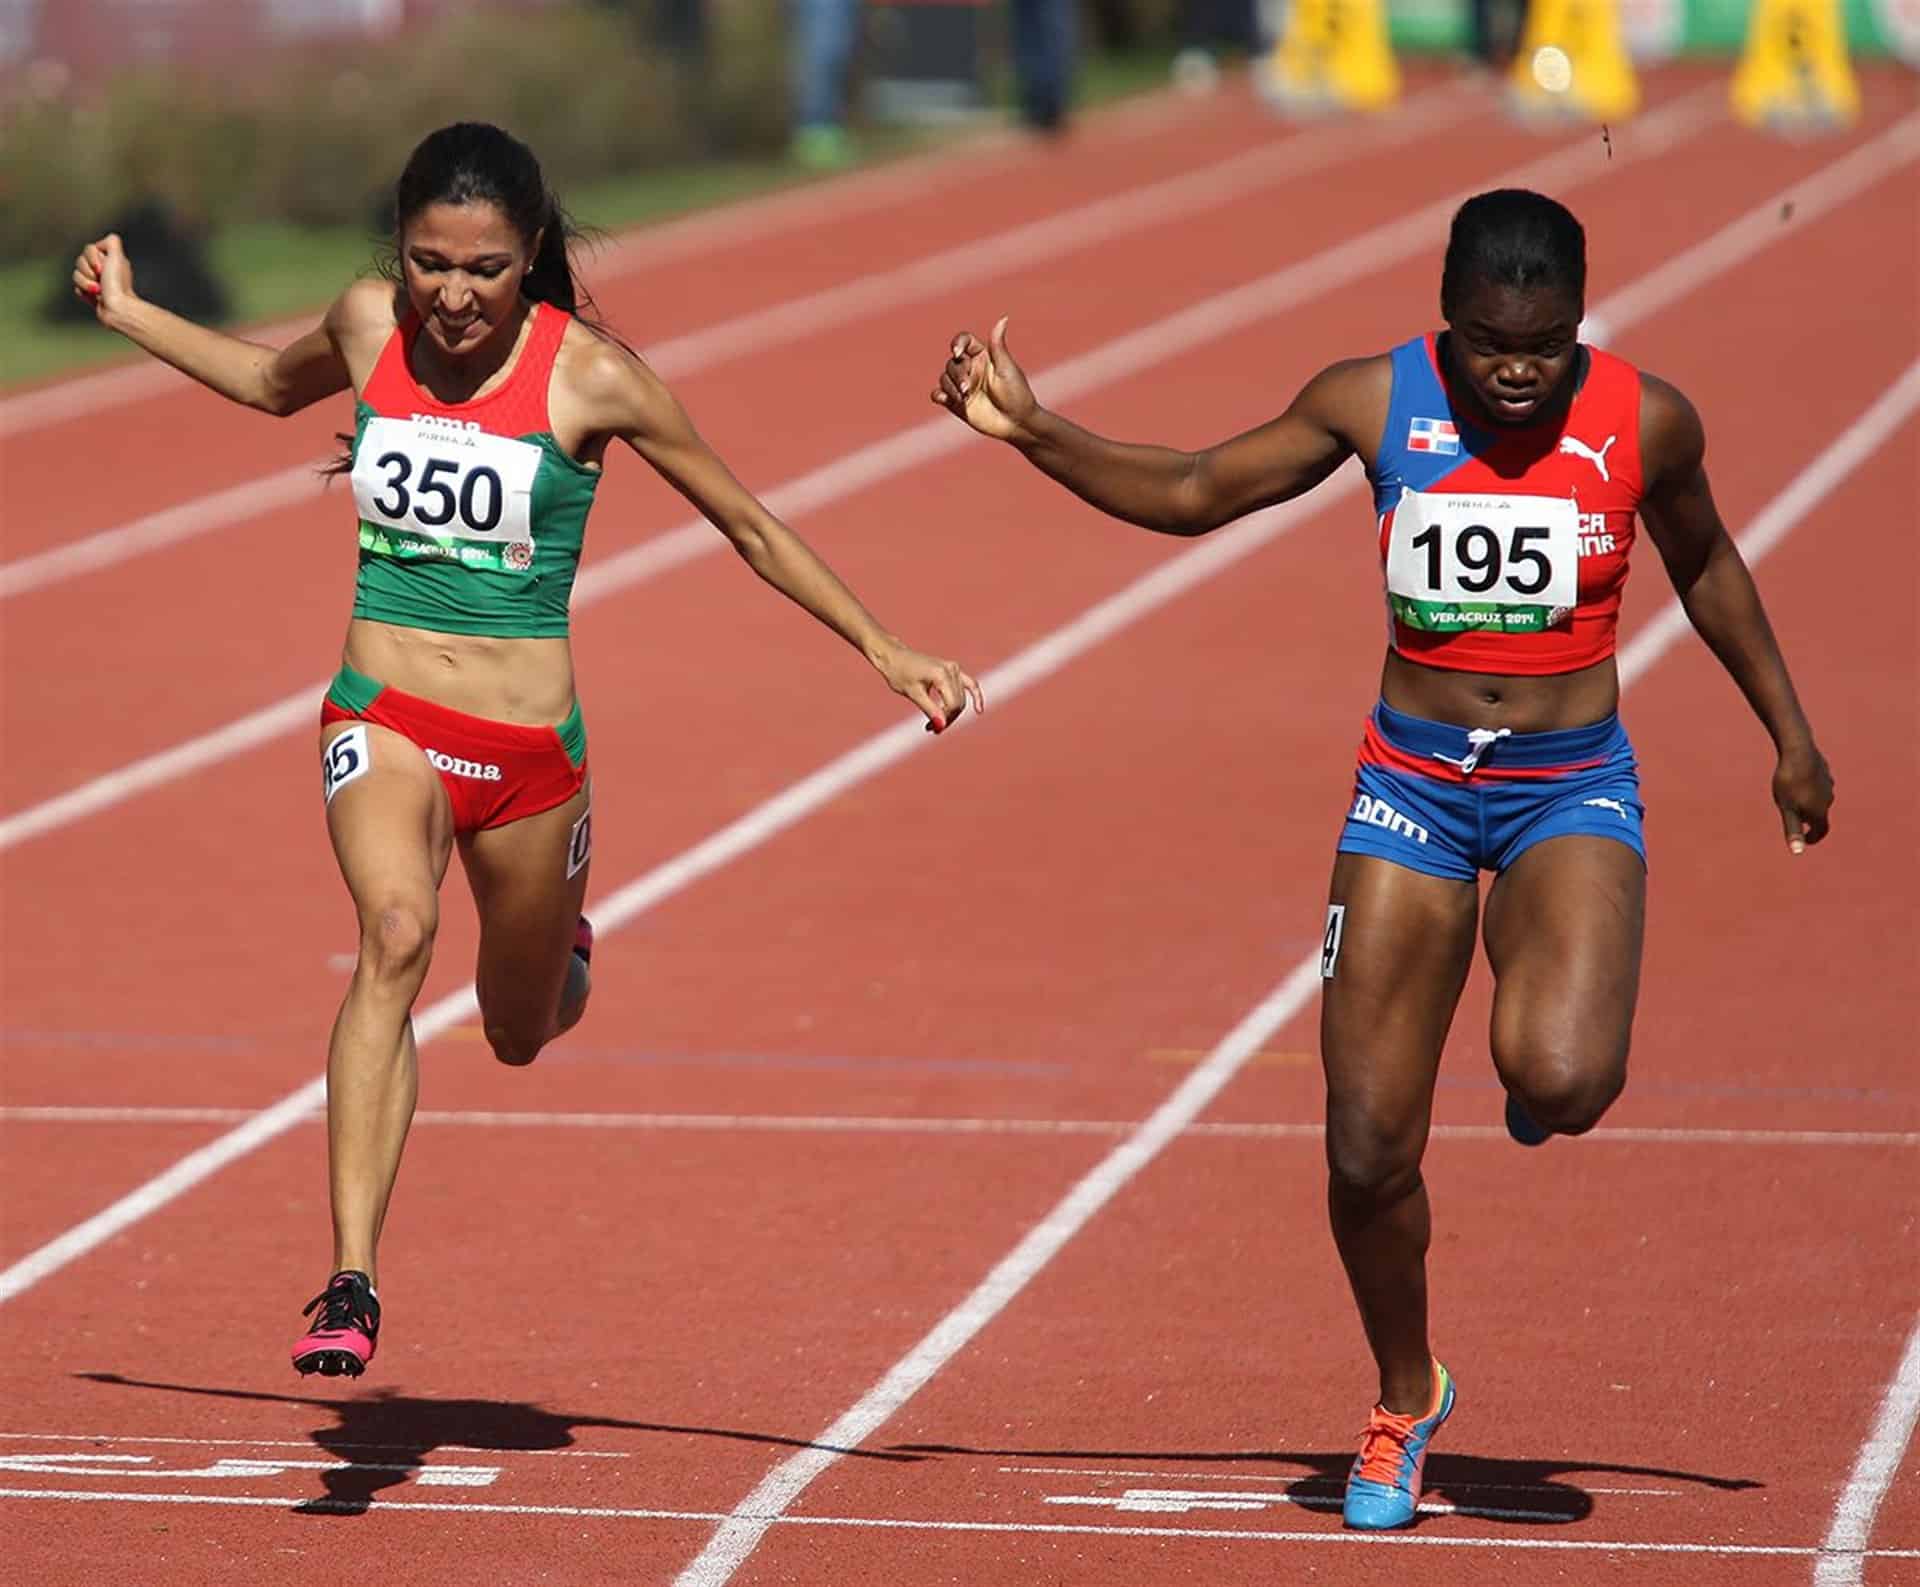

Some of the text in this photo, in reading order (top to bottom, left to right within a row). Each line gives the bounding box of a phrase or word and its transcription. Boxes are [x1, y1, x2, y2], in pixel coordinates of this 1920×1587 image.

[373, 451, 503, 532] 350
[1412, 524, 1552, 595] 195
[1429, 611, 1536, 625] VERACRUZ 2014
